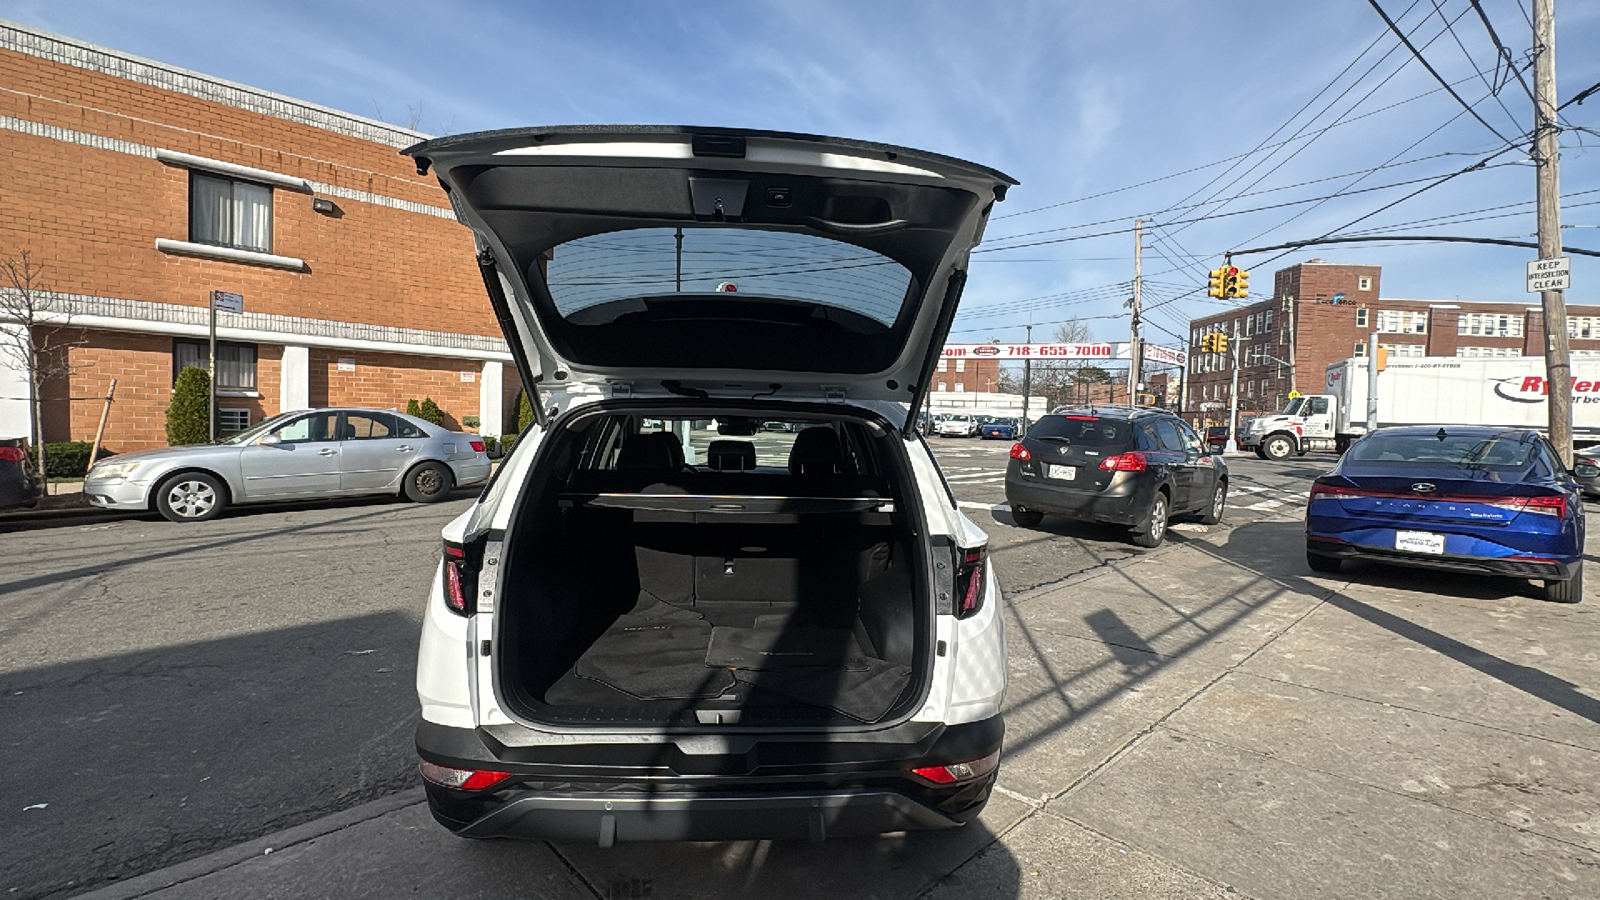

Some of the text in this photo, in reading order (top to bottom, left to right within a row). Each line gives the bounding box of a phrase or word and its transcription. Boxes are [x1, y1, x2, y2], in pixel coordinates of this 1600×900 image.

[1537, 261, 1560, 270] KEEP
[1528, 269, 1569, 280] INTERSECTION
[1533, 279, 1563, 289] CLEAR
